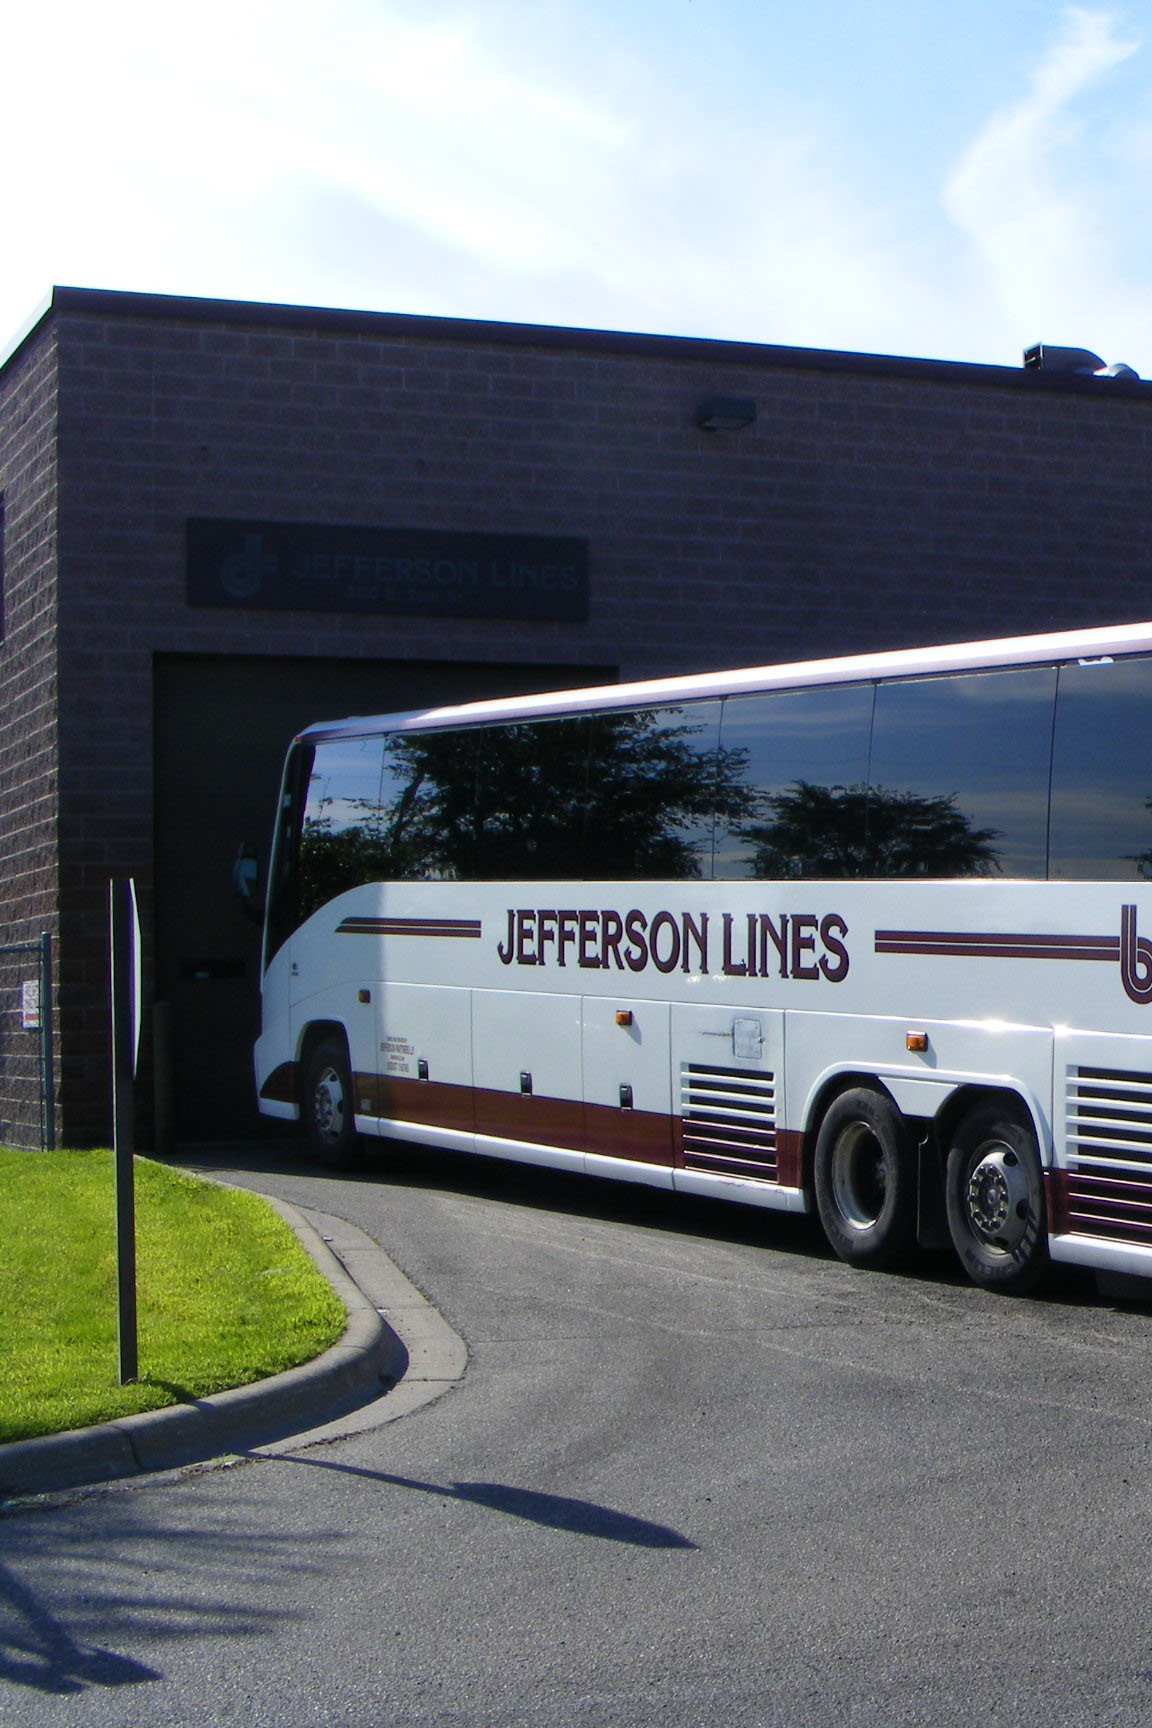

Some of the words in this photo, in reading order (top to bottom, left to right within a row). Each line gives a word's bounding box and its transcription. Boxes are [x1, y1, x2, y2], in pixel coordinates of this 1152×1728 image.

[295, 554, 478, 586] JEFFERSON
[489, 559, 578, 591] LINES
[497, 909, 709, 974] JEFFERSON
[722, 913, 850, 983] LINES
